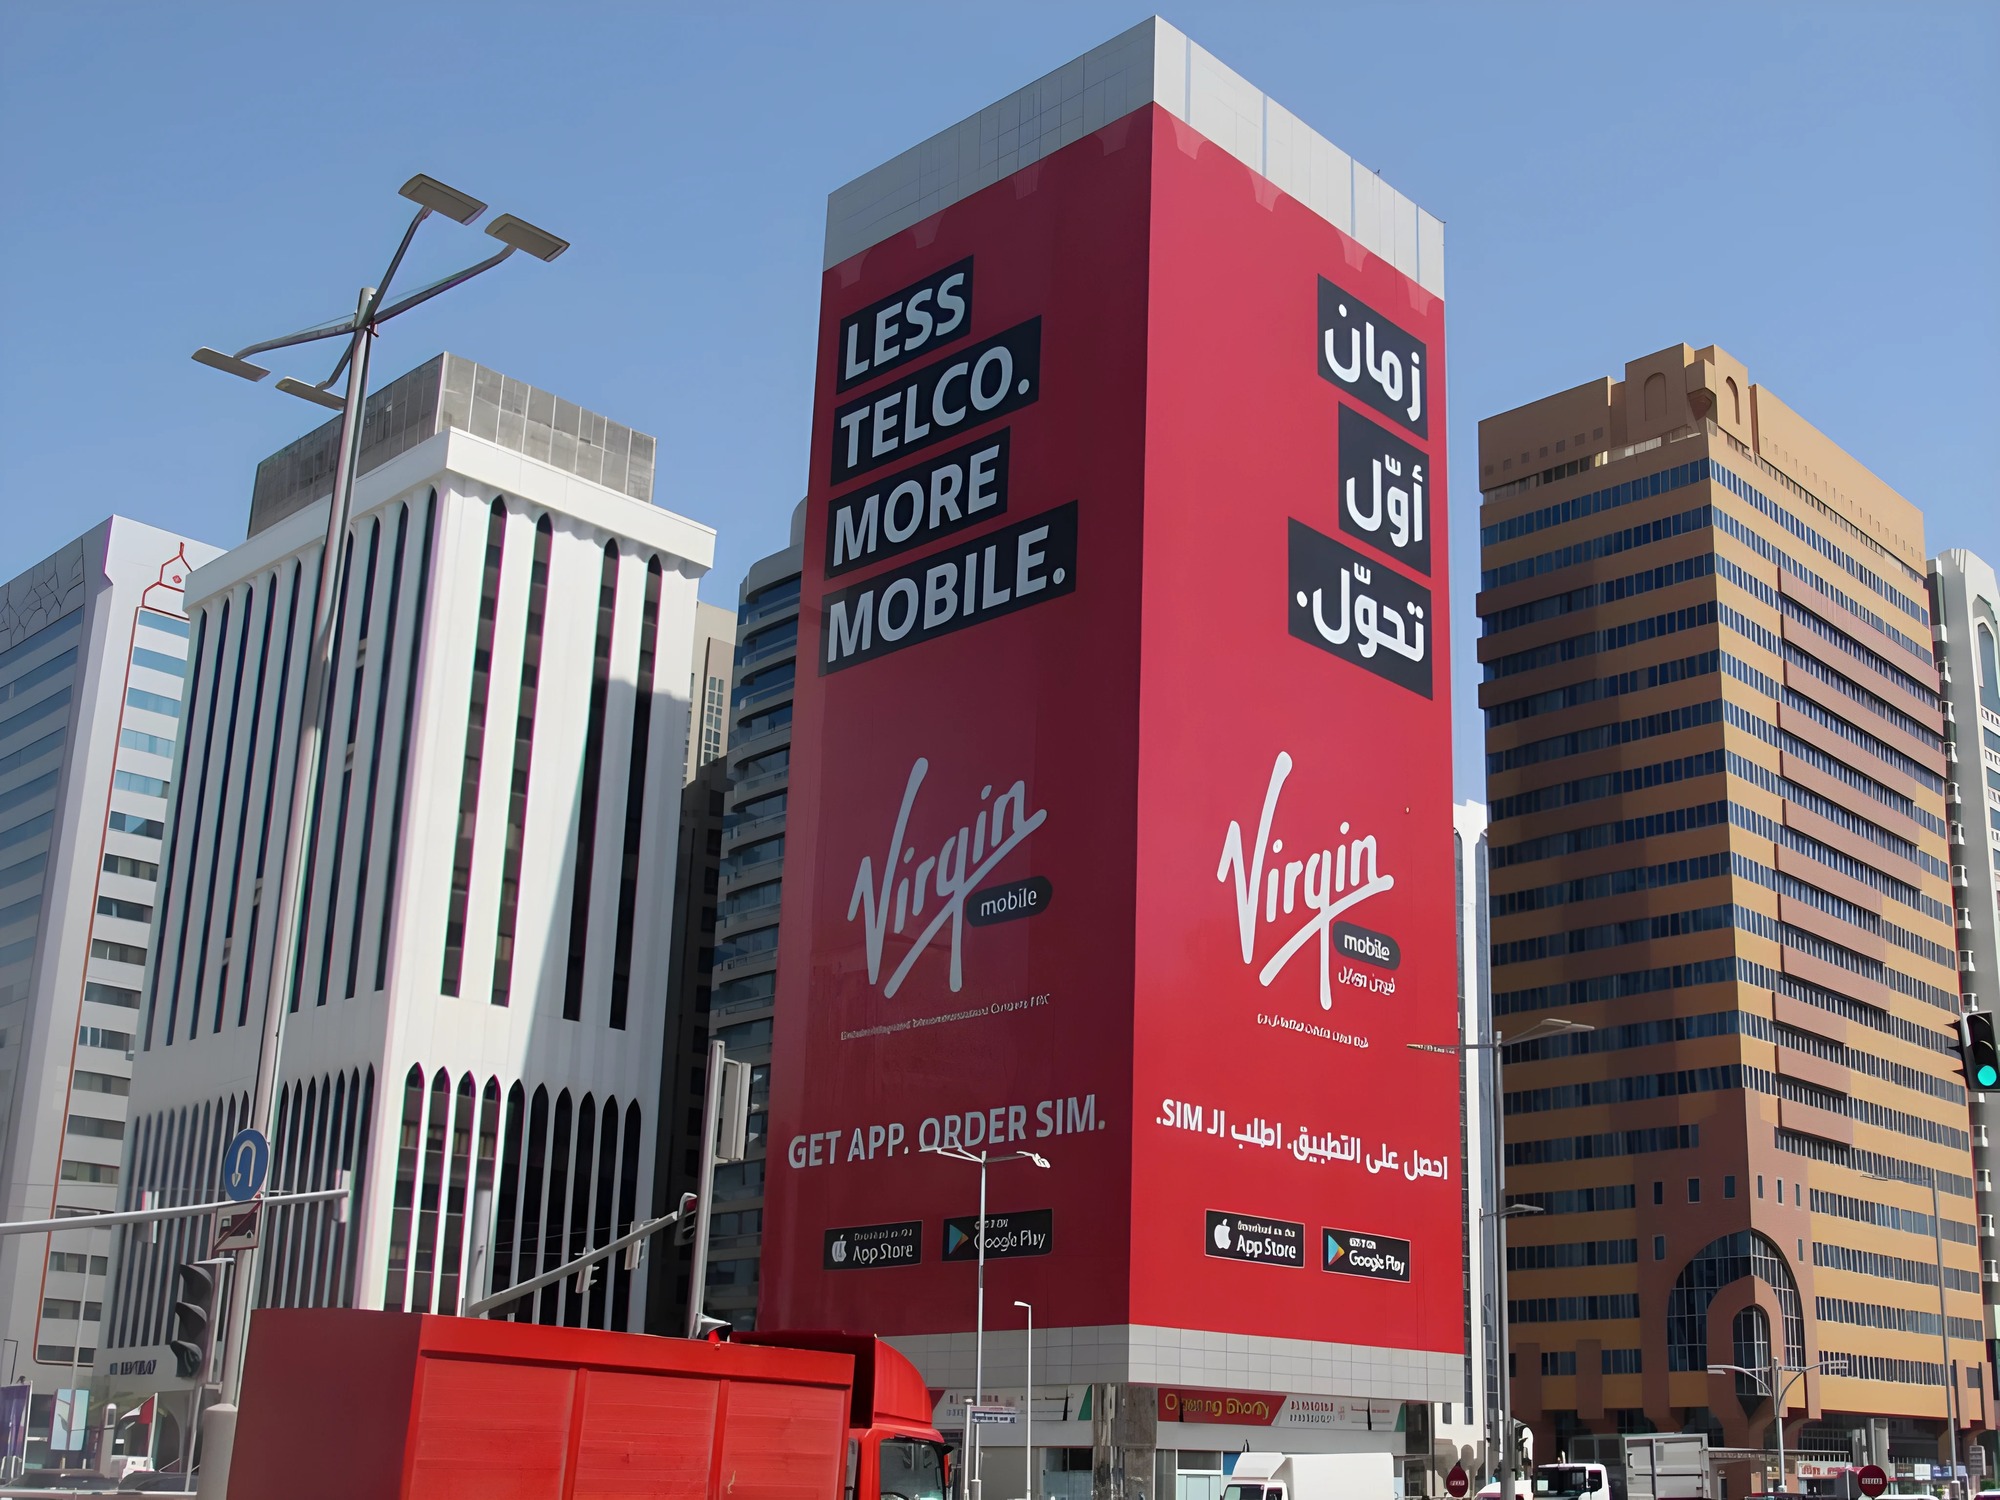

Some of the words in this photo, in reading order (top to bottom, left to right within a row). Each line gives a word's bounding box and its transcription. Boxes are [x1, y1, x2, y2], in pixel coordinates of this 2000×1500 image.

[845, 272, 965, 381] LESS
[1324, 303, 1421, 422] زمان
[840, 345, 1030, 468] TELCO.
[832, 444, 1000, 567] MORE
[827, 524, 1066, 663] MOBILE.
[847, 757, 1048, 999] Virgin
[980, 888, 1037, 917] mobile
[1217, 751, 1394, 1011] Virgin
[1344, 934, 1390, 961] mobile
[788, 1130, 842, 1169] GET
[847, 1123, 909, 1163] APP.
[919, 1105, 1027, 1149] ORDER
[1036, 1094, 1106, 1138] SIM.
[1230, 1117, 1282, 1149] اطلب
[1365, 1143, 1399, 1174] على
[1403, 1150, 1448, 1181] احصل
[879, 1243, 913, 1260] Store
[1236, 1234, 1262, 1258] App
[1264, 1238, 1296, 1259] Store
